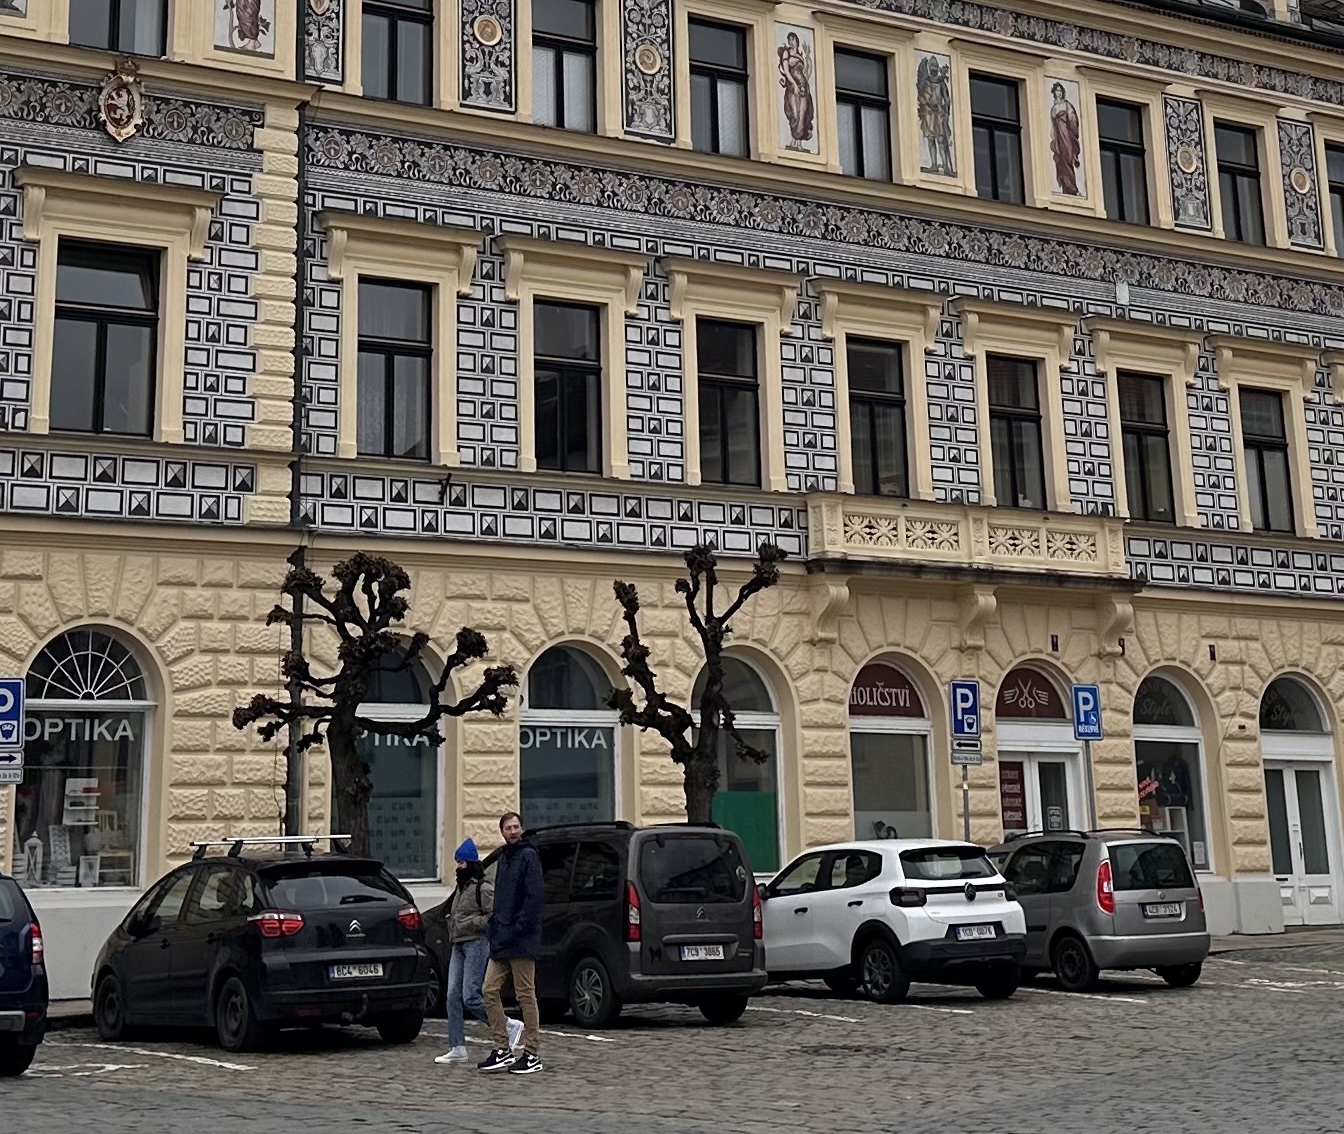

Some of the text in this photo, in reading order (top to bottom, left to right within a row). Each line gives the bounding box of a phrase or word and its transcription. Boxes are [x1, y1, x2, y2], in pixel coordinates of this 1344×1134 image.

[956, 688, 973, 720] P
[1078, 692, 1094, 722] P
[25, 717, 135, 741] OPTIKA
[520, 727, 608, 749] OPTIKA
